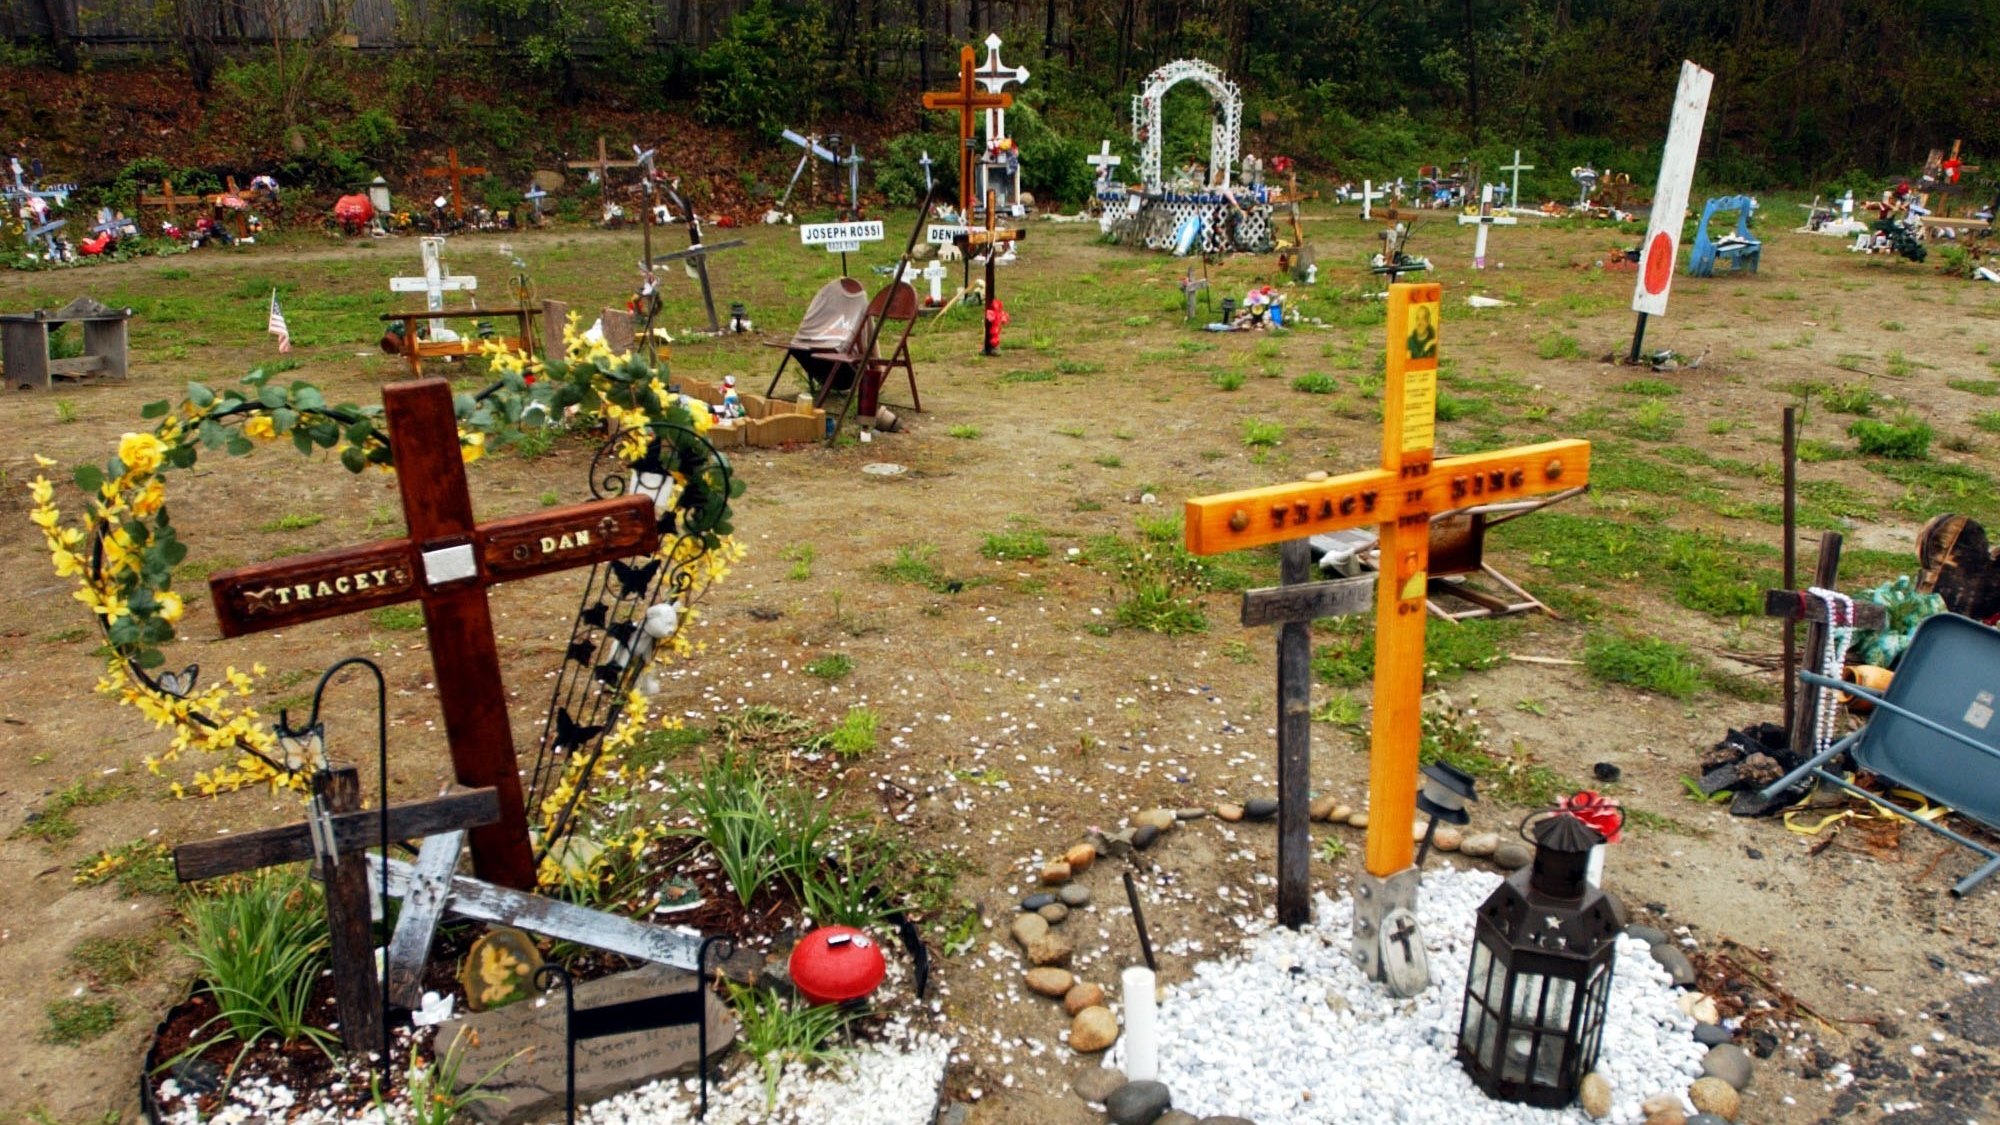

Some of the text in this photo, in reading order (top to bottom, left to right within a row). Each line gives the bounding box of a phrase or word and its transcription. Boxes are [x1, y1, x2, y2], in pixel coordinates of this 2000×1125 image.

[806, 225, 880, 240] JOSEPH ROSSI
[1269, 491, 1379, 529] TRACY
[1452, 467, 1524, 501] KING
[540, 530, 590, 553] DAN
[275, 570, 389, 604] TRACEY
